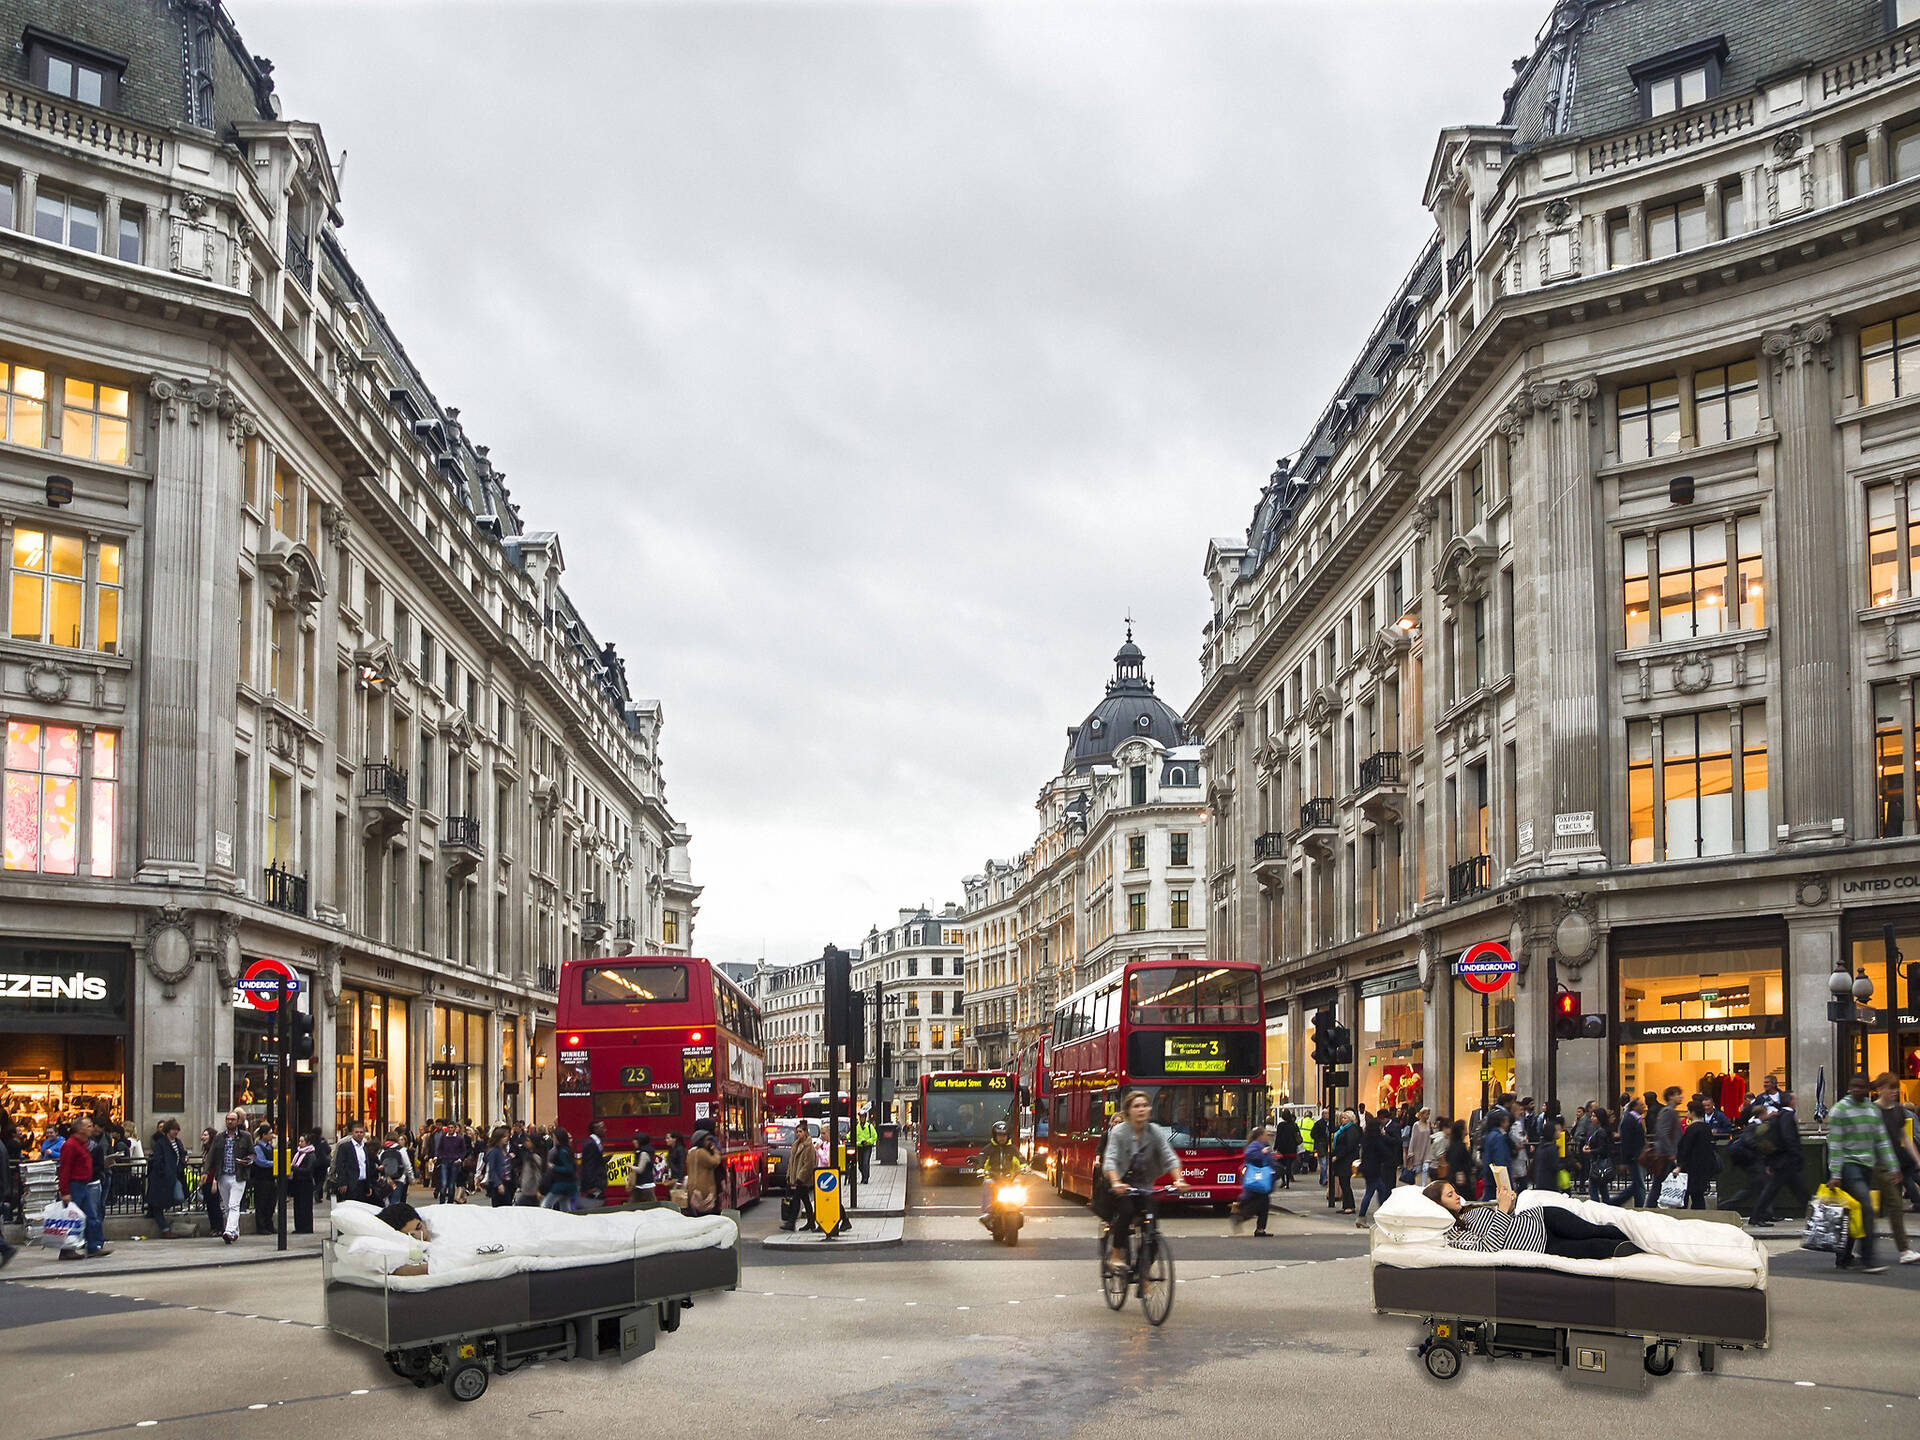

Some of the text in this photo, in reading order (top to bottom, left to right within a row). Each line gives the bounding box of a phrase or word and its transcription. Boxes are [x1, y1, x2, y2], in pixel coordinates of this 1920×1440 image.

[1558, 815, 1585, 823] OXFORD
[1558, 823, 1582, 831] CIRCUS
[1843, 879, 1891, 893] UNITED
[1460, 963, 1516, 972] UNDERGROUND
[1643, 1027, 1671, 1035] UNITED
[1671, 1025, 1703, 1034] COLORS
[1715, 1023, 1756, 1031] BENETTON
[1209, 1040, 1219, 1055] 3
[626, 1068, 646, 1082] 23
[933, 1077, 1007, 1088] Great Portland Street 453
[1180, 1168, 1205, 1176] abellio
